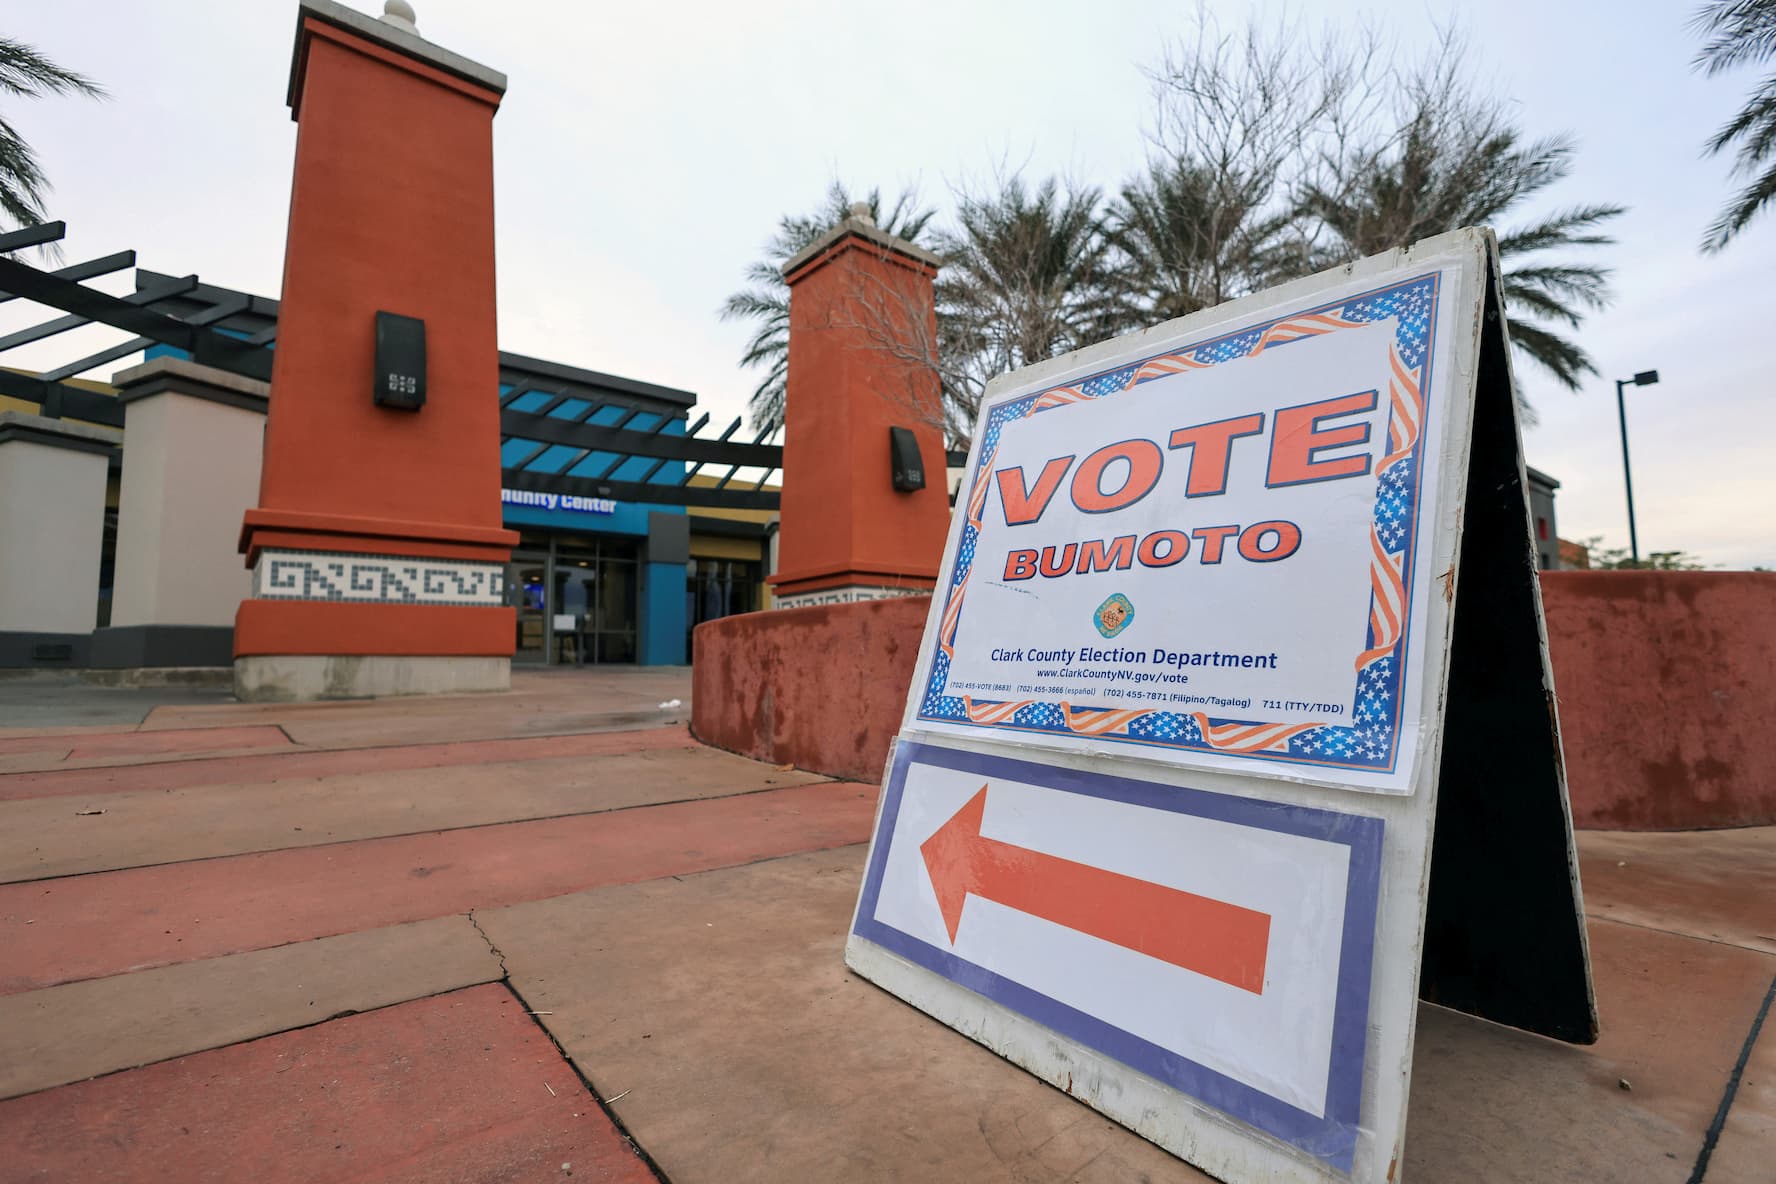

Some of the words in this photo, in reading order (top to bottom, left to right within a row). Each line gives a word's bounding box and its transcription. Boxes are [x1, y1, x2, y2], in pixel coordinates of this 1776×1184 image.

[995, 389, 1378, 527] VOTE
[1002, 519, 1302, 582] BUMOTO
[991, 648, 1023, 662] Clark
[1027, 649, 1075, 666] County
[1079, 647, 1147, 664] Election
[1152, 648, 1278, 670] Department
[1036, 668, 1189, 684] www.ClarkCountyNV.gov/vote
[950, 681, 965, 689] (702)
[1016, 685, 1033, 693] (702)
[1034, 686, 1064, 694] 455-3666
[1064, 686, 1096, 696] (español)
[1103, 688, 1125, 698] (702)
[1126, 690, 1167, 701] 455-7871
[1169, 693, 1251, 709] (Filipino/Tagalog)
[1262, 700, 1281, 710] 711
[1285, 701, 1344, 715] (TTY/TDD)
